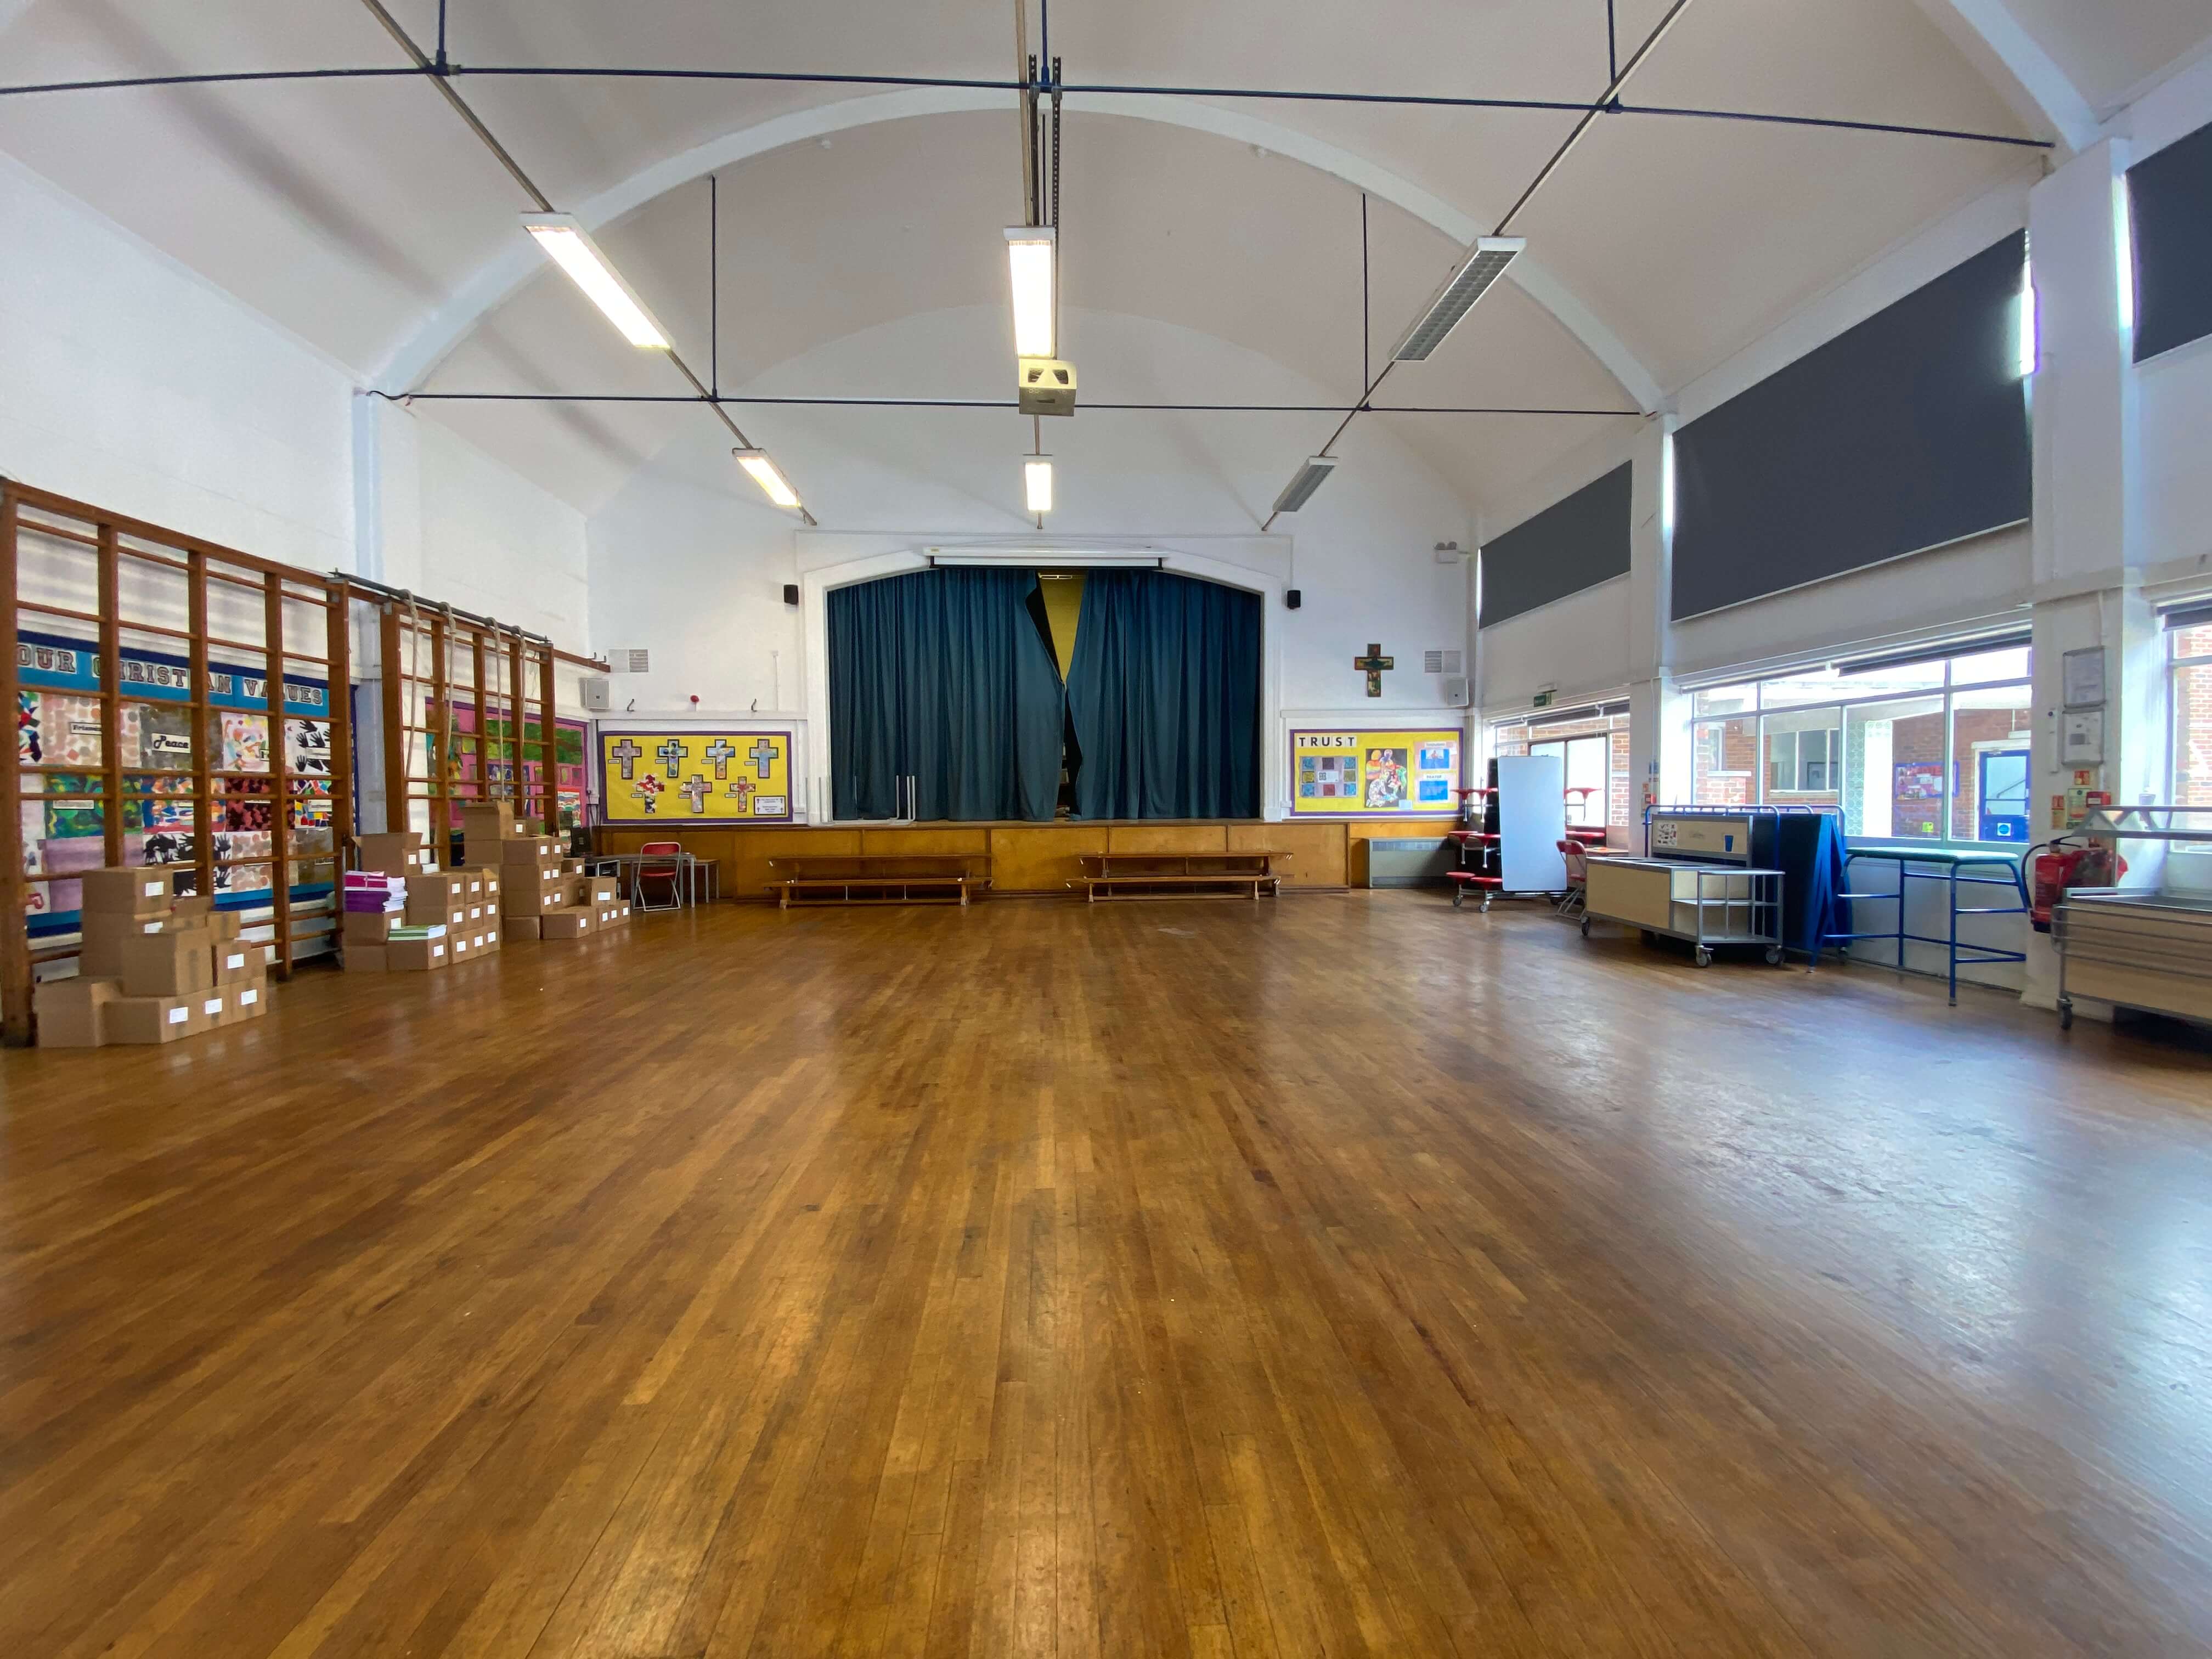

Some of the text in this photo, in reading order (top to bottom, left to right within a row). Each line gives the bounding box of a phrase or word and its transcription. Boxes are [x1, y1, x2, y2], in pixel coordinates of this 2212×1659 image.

[17, 645, 321, 704] OUR RISTN VUES
[154, 735, 189, 749] Peace
[1299, 737, 1354, 747] TRUST
